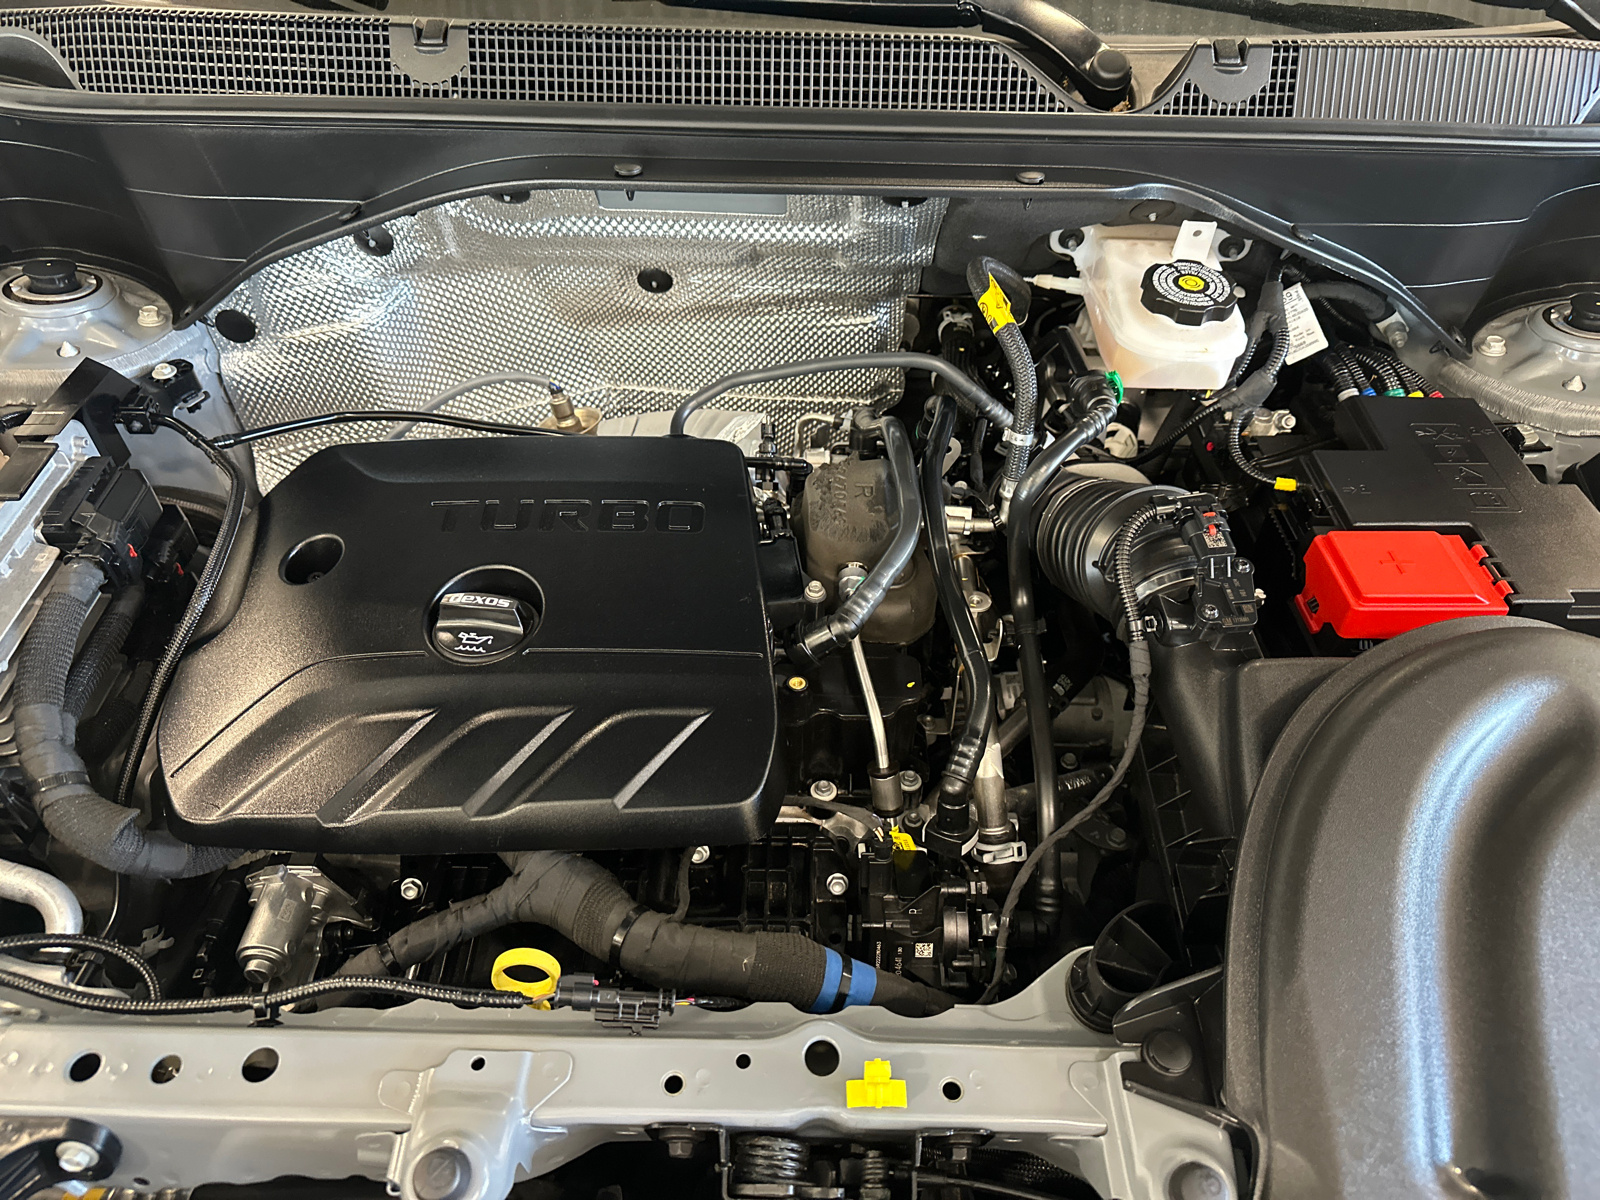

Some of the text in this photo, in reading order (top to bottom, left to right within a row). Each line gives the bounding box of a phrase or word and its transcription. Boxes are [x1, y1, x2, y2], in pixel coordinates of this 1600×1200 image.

[855, 482, 875, 498] R
[431, 499, 706, 534] TURBO
[448, 593, 513, 608] dexos
